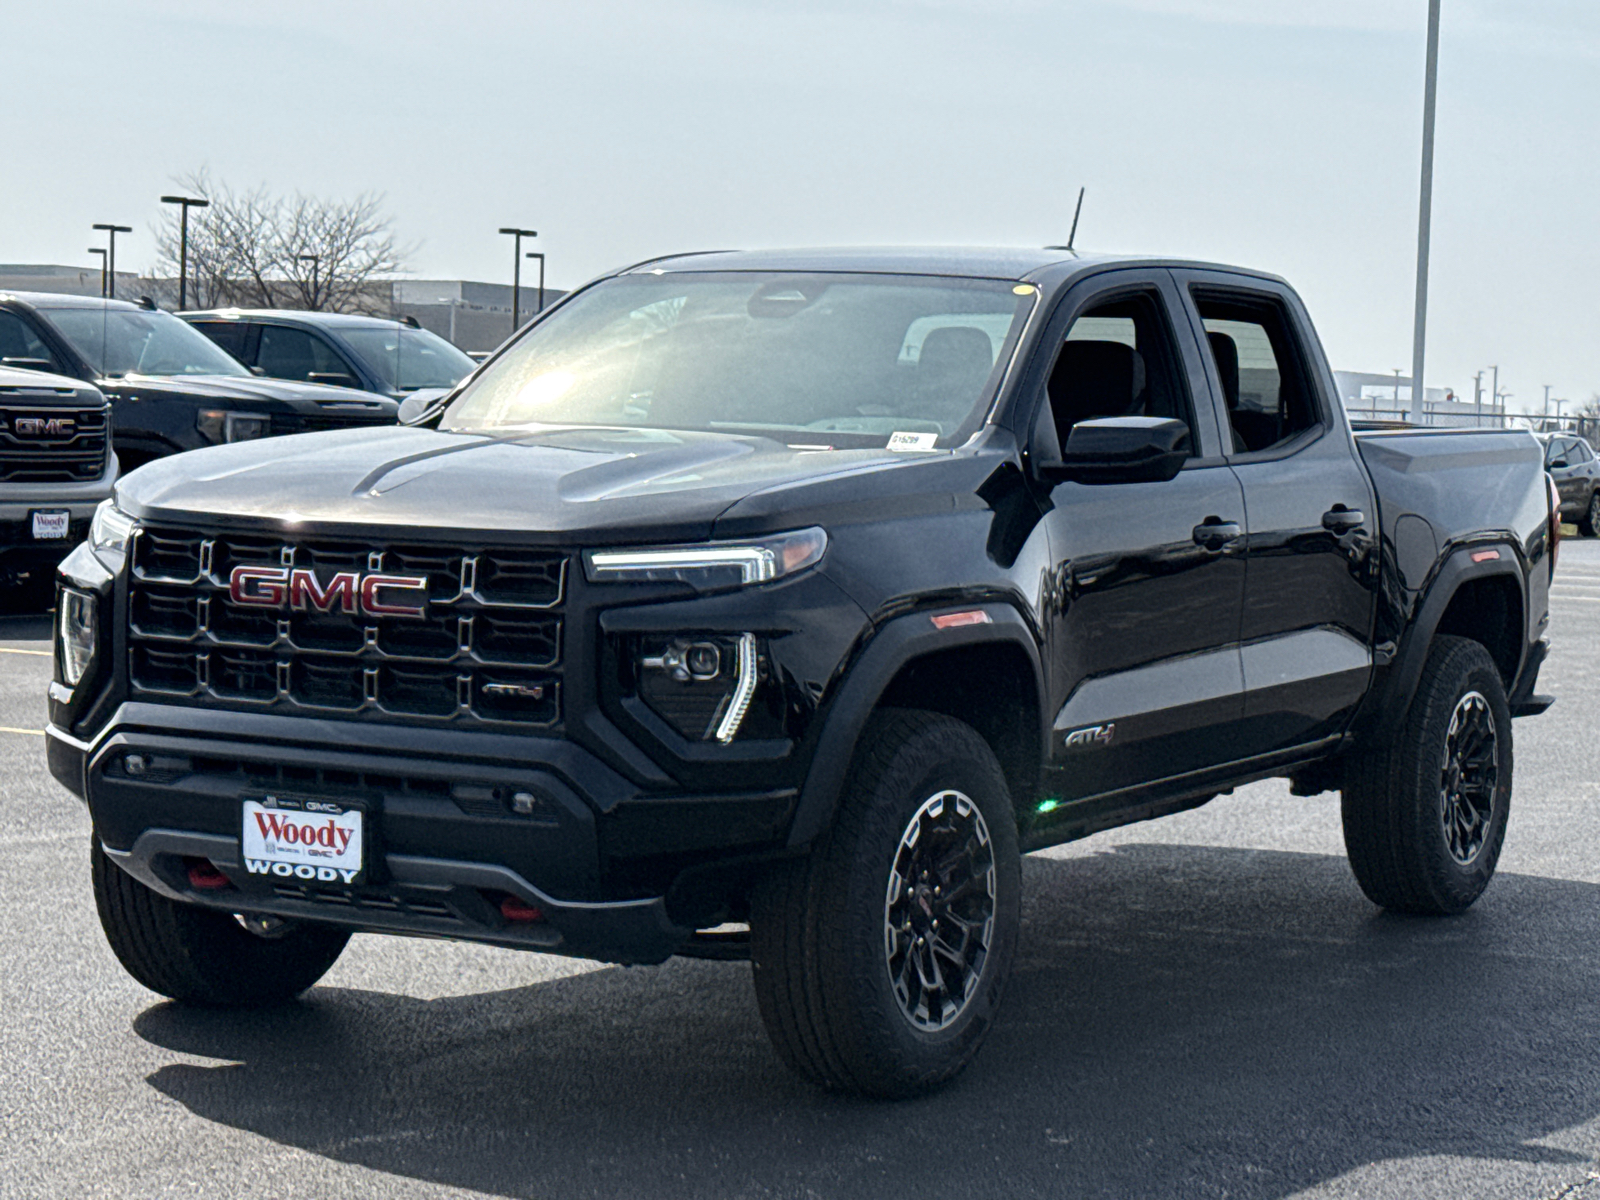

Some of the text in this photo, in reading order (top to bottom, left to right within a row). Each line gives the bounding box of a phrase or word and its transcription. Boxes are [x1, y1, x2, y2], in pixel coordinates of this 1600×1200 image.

[15, 418, 75, 435] GMC
[36, 515, 66, 529] Woody
[229, 564, 428, 620] GMC
[1065, 723, 1115, 748] AT4
[305, 801, 337, 812] GMC
[253, 811, 355, 856] Woody
[307, 849, 333, 859] GMC
[244, 858, 360, 884] WOODY
